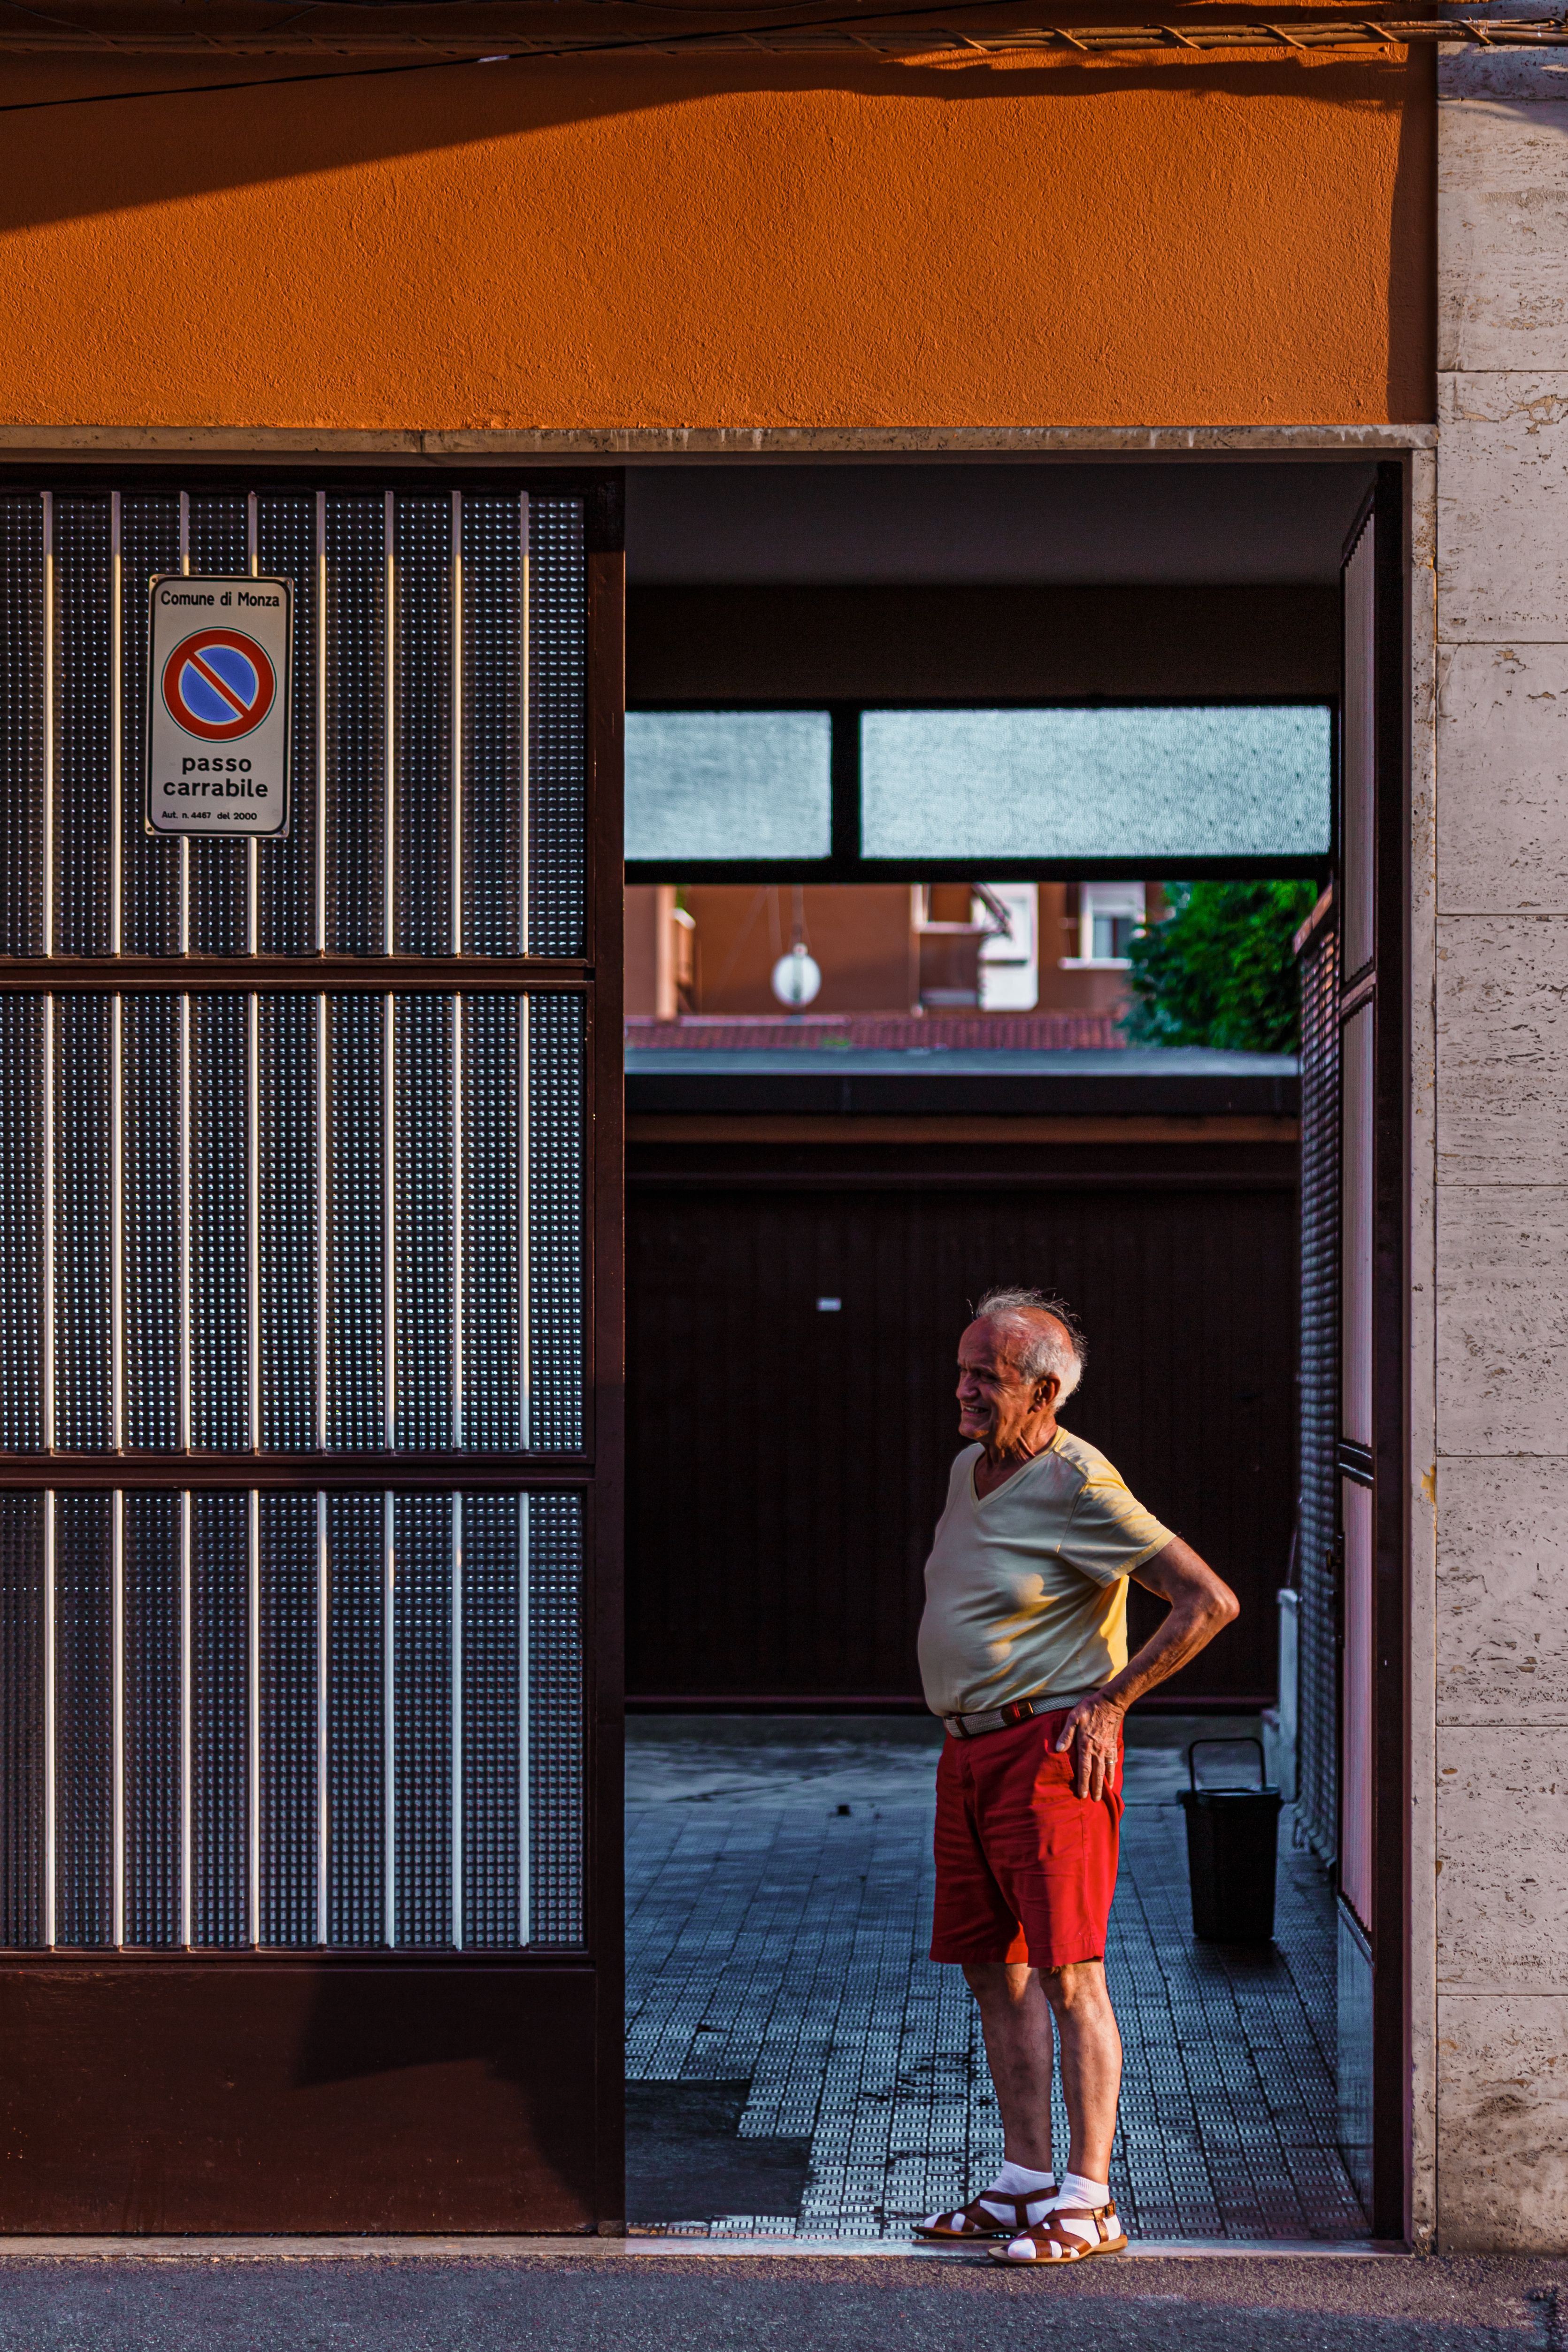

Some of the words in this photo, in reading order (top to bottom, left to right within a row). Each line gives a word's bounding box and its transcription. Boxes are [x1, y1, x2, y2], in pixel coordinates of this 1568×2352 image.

[161, 590, 215, 605] Comune
[220, 591, 232, 606] di
[238, 592, 280, 607] Monza
[182, 757, 252, 775] passo
[163, 778, 268, 797] carrabile
